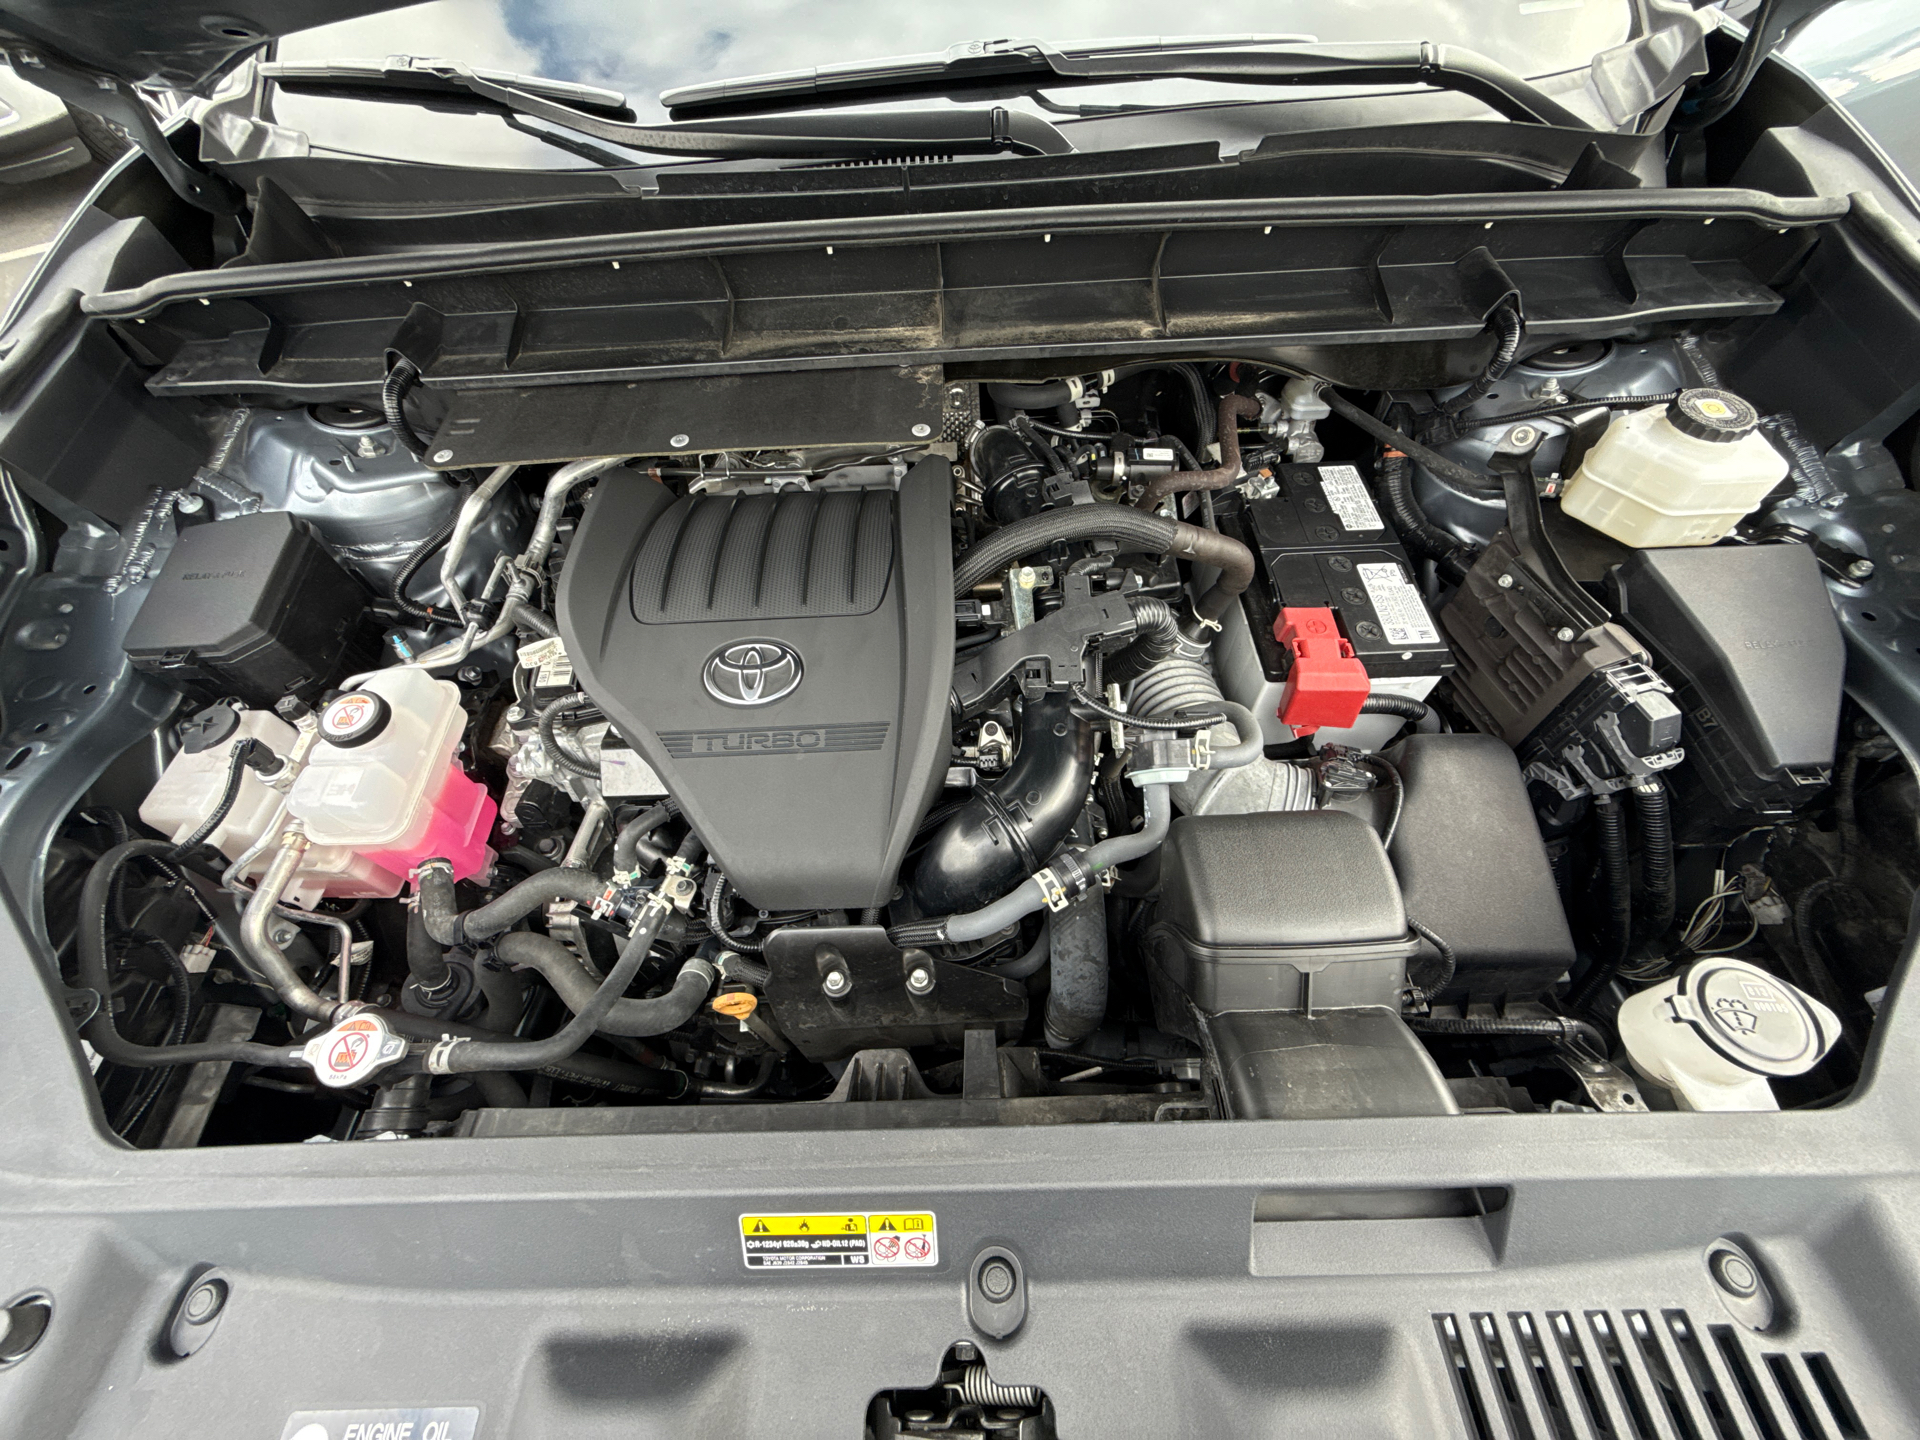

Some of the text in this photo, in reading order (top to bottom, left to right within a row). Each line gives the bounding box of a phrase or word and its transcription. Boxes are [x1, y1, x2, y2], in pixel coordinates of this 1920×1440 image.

[1744, 639, 1779, 649] RELAY
[1696, 707, 1719, 728] B7
[697, 730, 821, 751] TURBO
[850, 1256, 865, 1264] WS
[343, 1421, 452, 1440] ENGINE OIL
